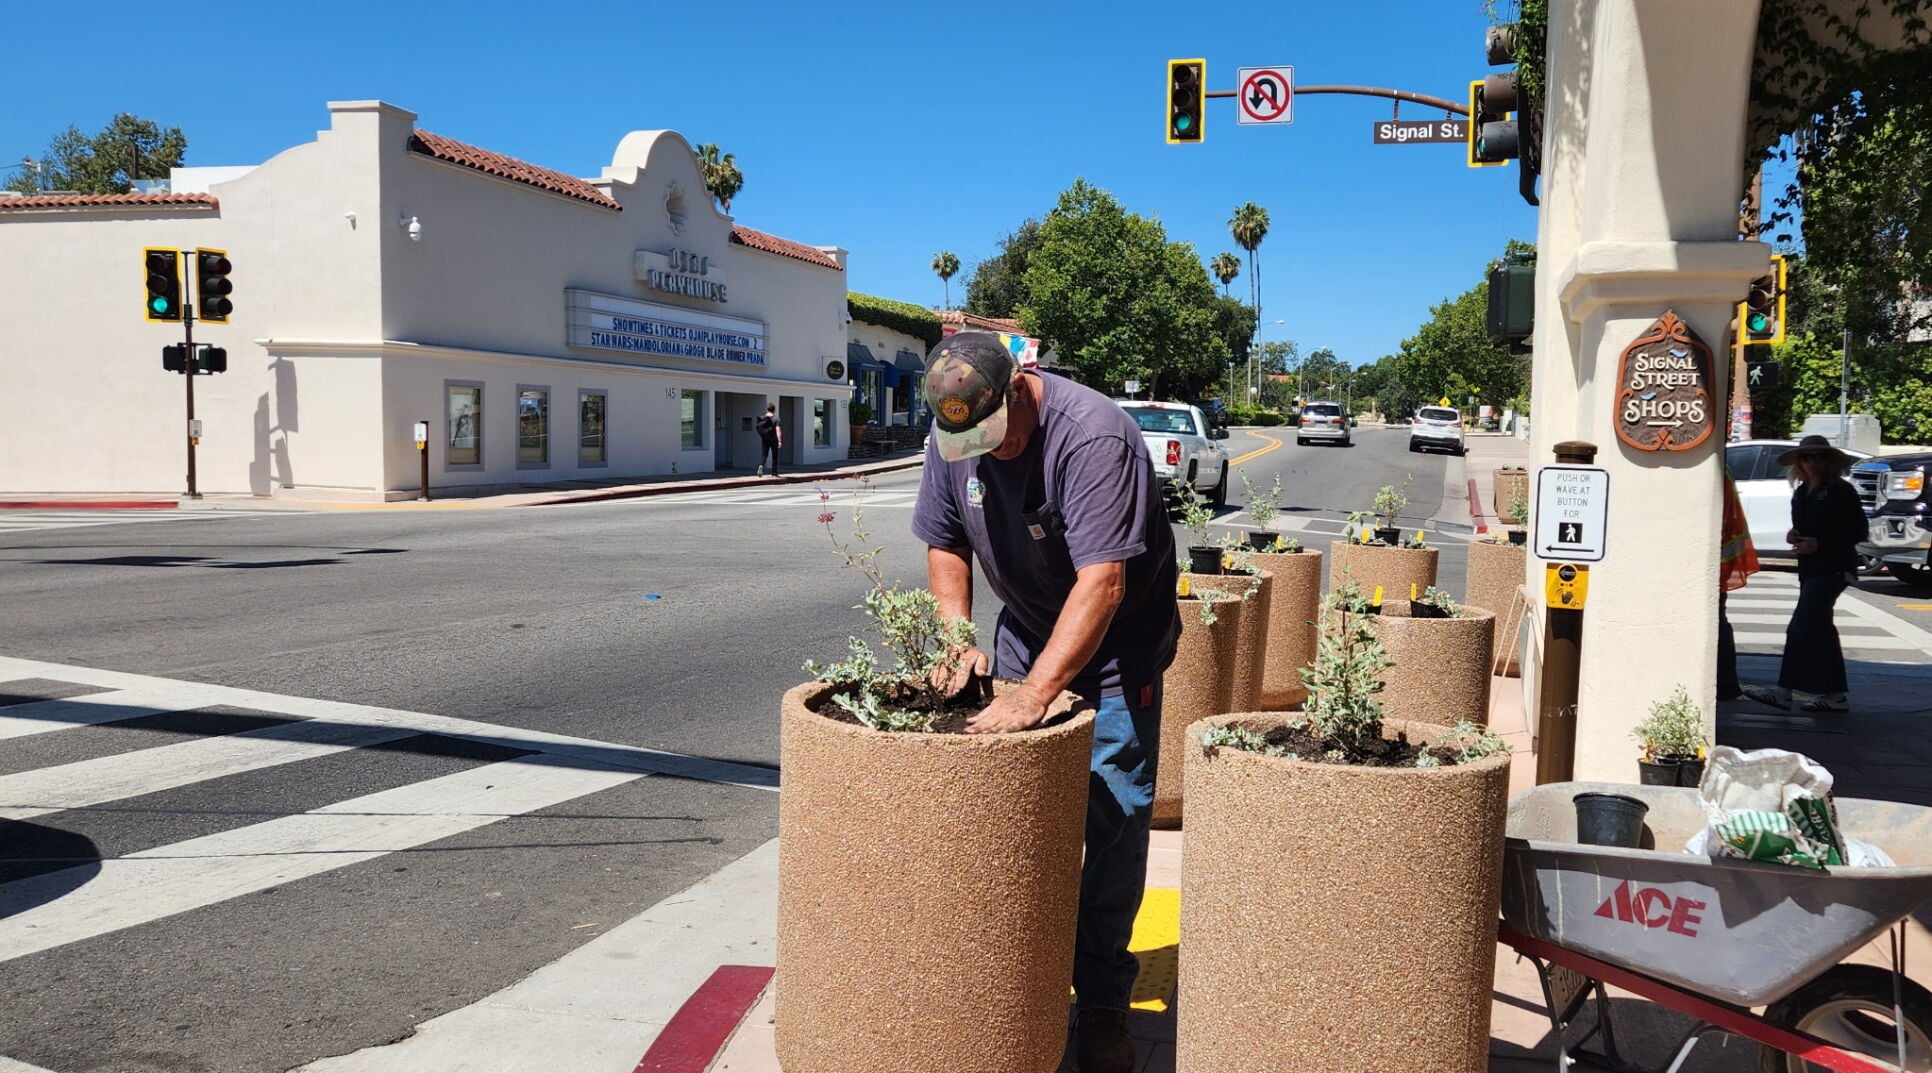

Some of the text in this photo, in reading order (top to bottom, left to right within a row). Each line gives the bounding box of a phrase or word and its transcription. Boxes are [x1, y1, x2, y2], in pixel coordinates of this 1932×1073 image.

[1380, 123, 1464, 142] Signal St.
[647, 269, 728, 303] PLAYHOUSE
[613, 317, 653, 335] SHOWTIMES
[660, 324, 687, 339] TICKETS
[706, 346, 725, 360] BLADE
[726, 349, 746, 362] RUNNER
[665, 387, 676, 400] 145
[1624, 400, 1705, 423] SHOPS
[1557, 473, 1591, 483] PUSH OR
[1556, 485, 1591, 495] WAVE AT
[1557, 497, 1588, 507] BUTTON
[1564, 508, 1579, 518] FOR
[1593, 879, 1708, 938] ACE
